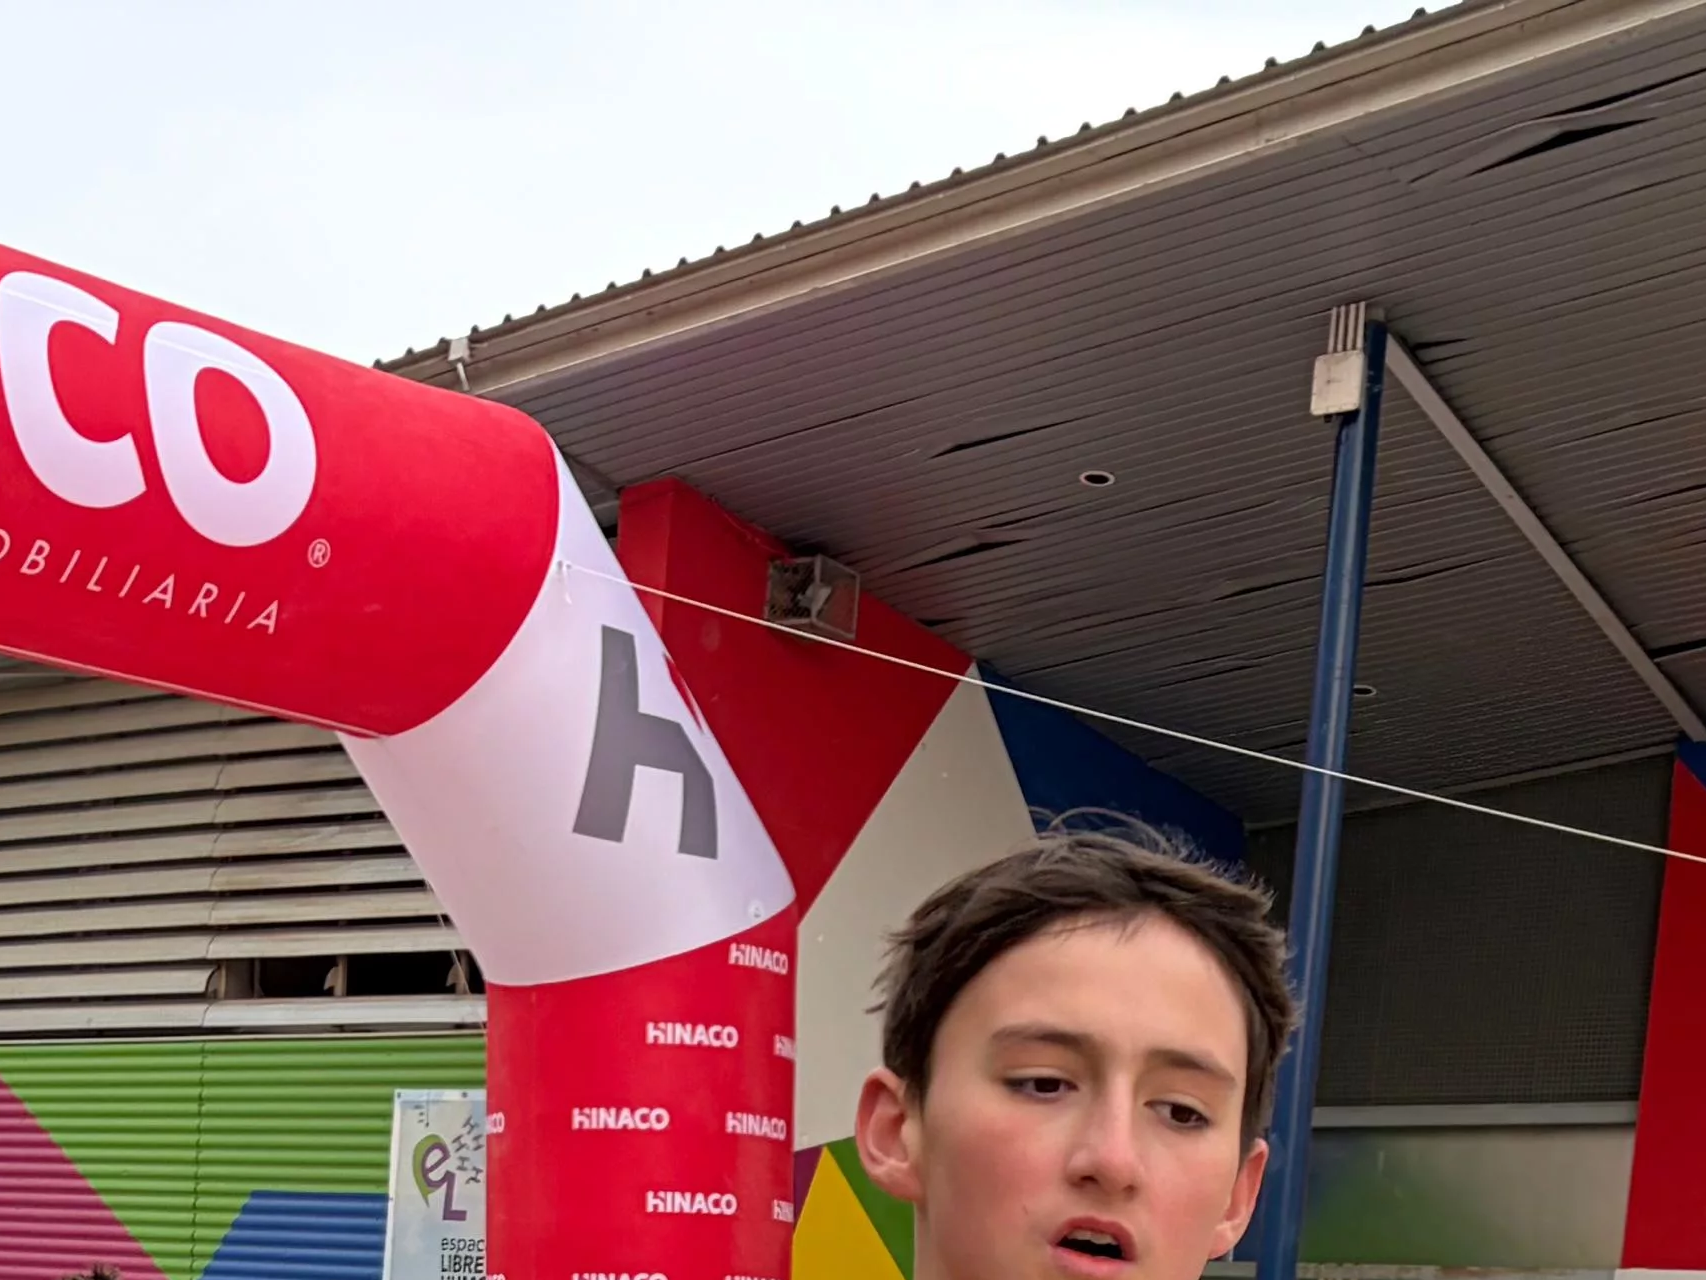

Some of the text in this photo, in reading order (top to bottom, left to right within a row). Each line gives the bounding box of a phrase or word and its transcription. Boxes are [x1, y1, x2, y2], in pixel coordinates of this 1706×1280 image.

[728, 943, 789, 975] HINACO
[646, 1021, 739, 1049] HINACO
[571, 1107, 670, 1131] HINACO
[725, 1111, 787, 1141] HINACO
[646, 1189, 738, 1215] HINACO
[441, 1237, 486, 1254] espac
[440, 1254, 485, 1274] LIBRE
